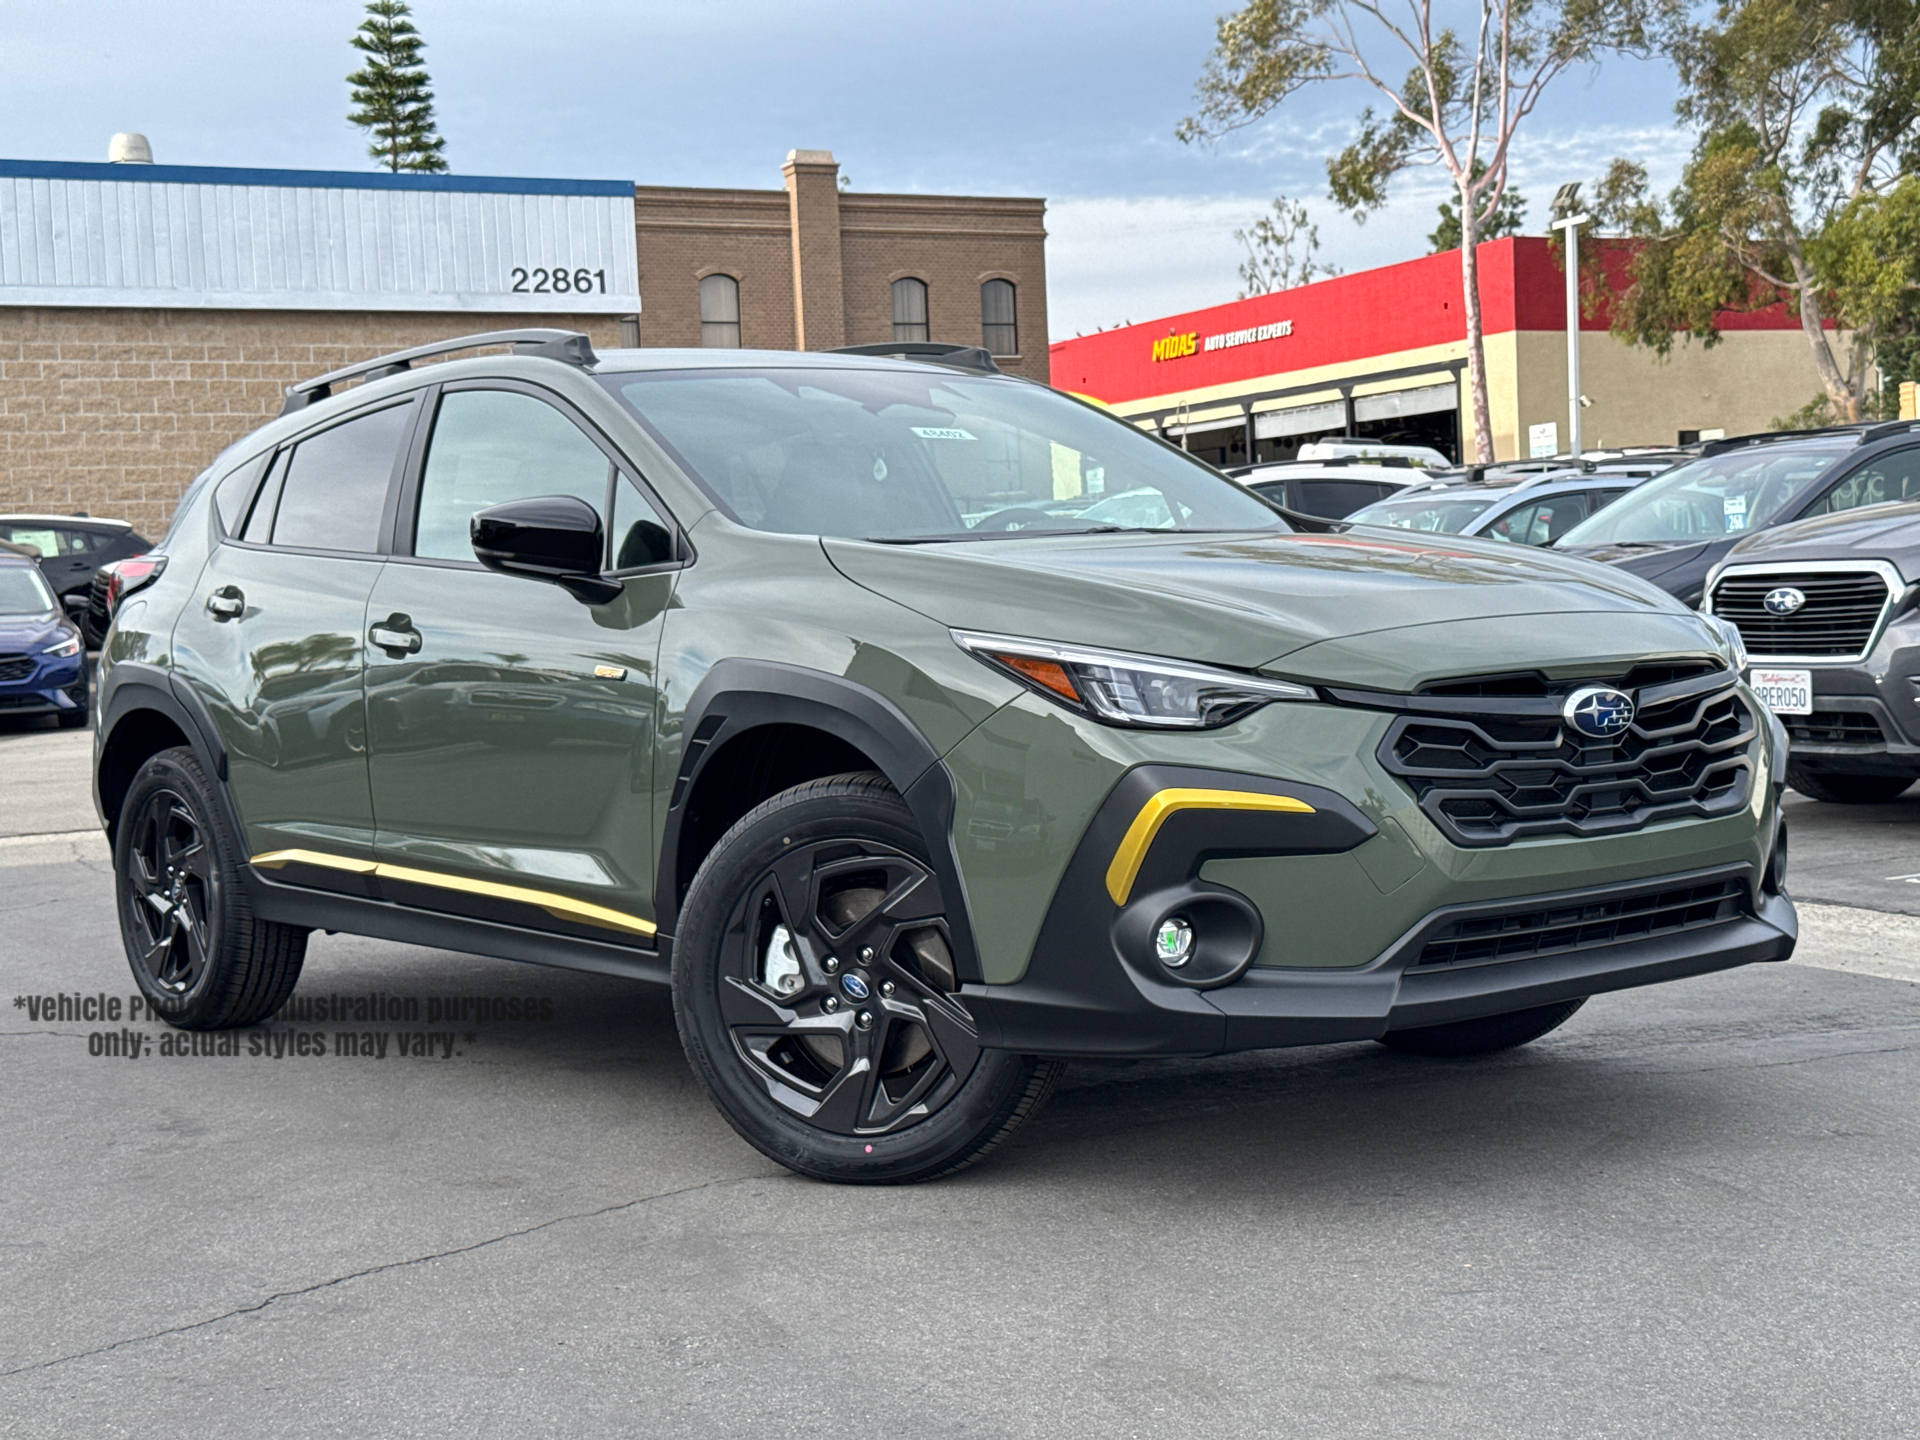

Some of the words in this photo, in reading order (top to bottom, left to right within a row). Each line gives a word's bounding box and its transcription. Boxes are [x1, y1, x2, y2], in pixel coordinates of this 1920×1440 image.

[511, 267, 606, 294] 22861
[1203, 334, 1225, 352] AUTO
[1225, 327, 1257, 348] SERVICE
[1257, 320, 1294, 342] EXPERTS
